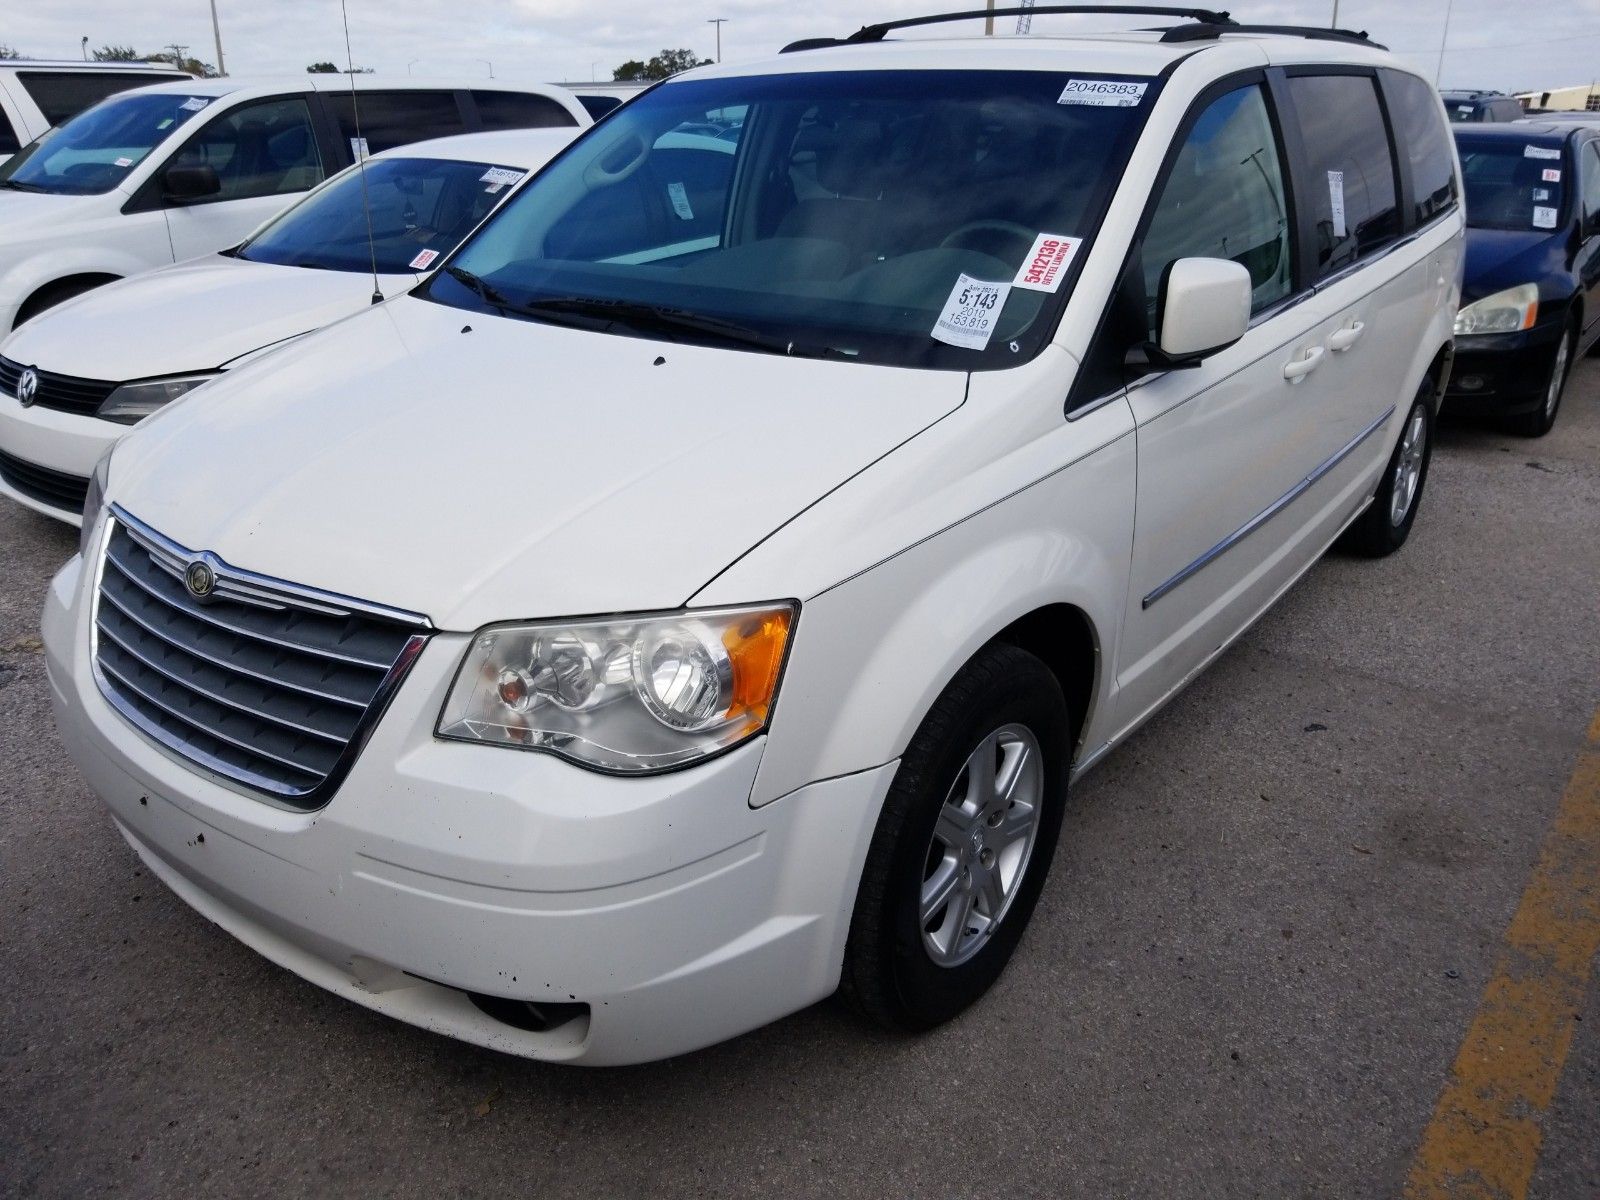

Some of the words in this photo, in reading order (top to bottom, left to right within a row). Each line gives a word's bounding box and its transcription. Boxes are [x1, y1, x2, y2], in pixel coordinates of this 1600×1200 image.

[1066, 82, 1138, 94] 2046383
[1024, 240, 1060, 284] 5412136
[960, 306, 986, 318] 2010
